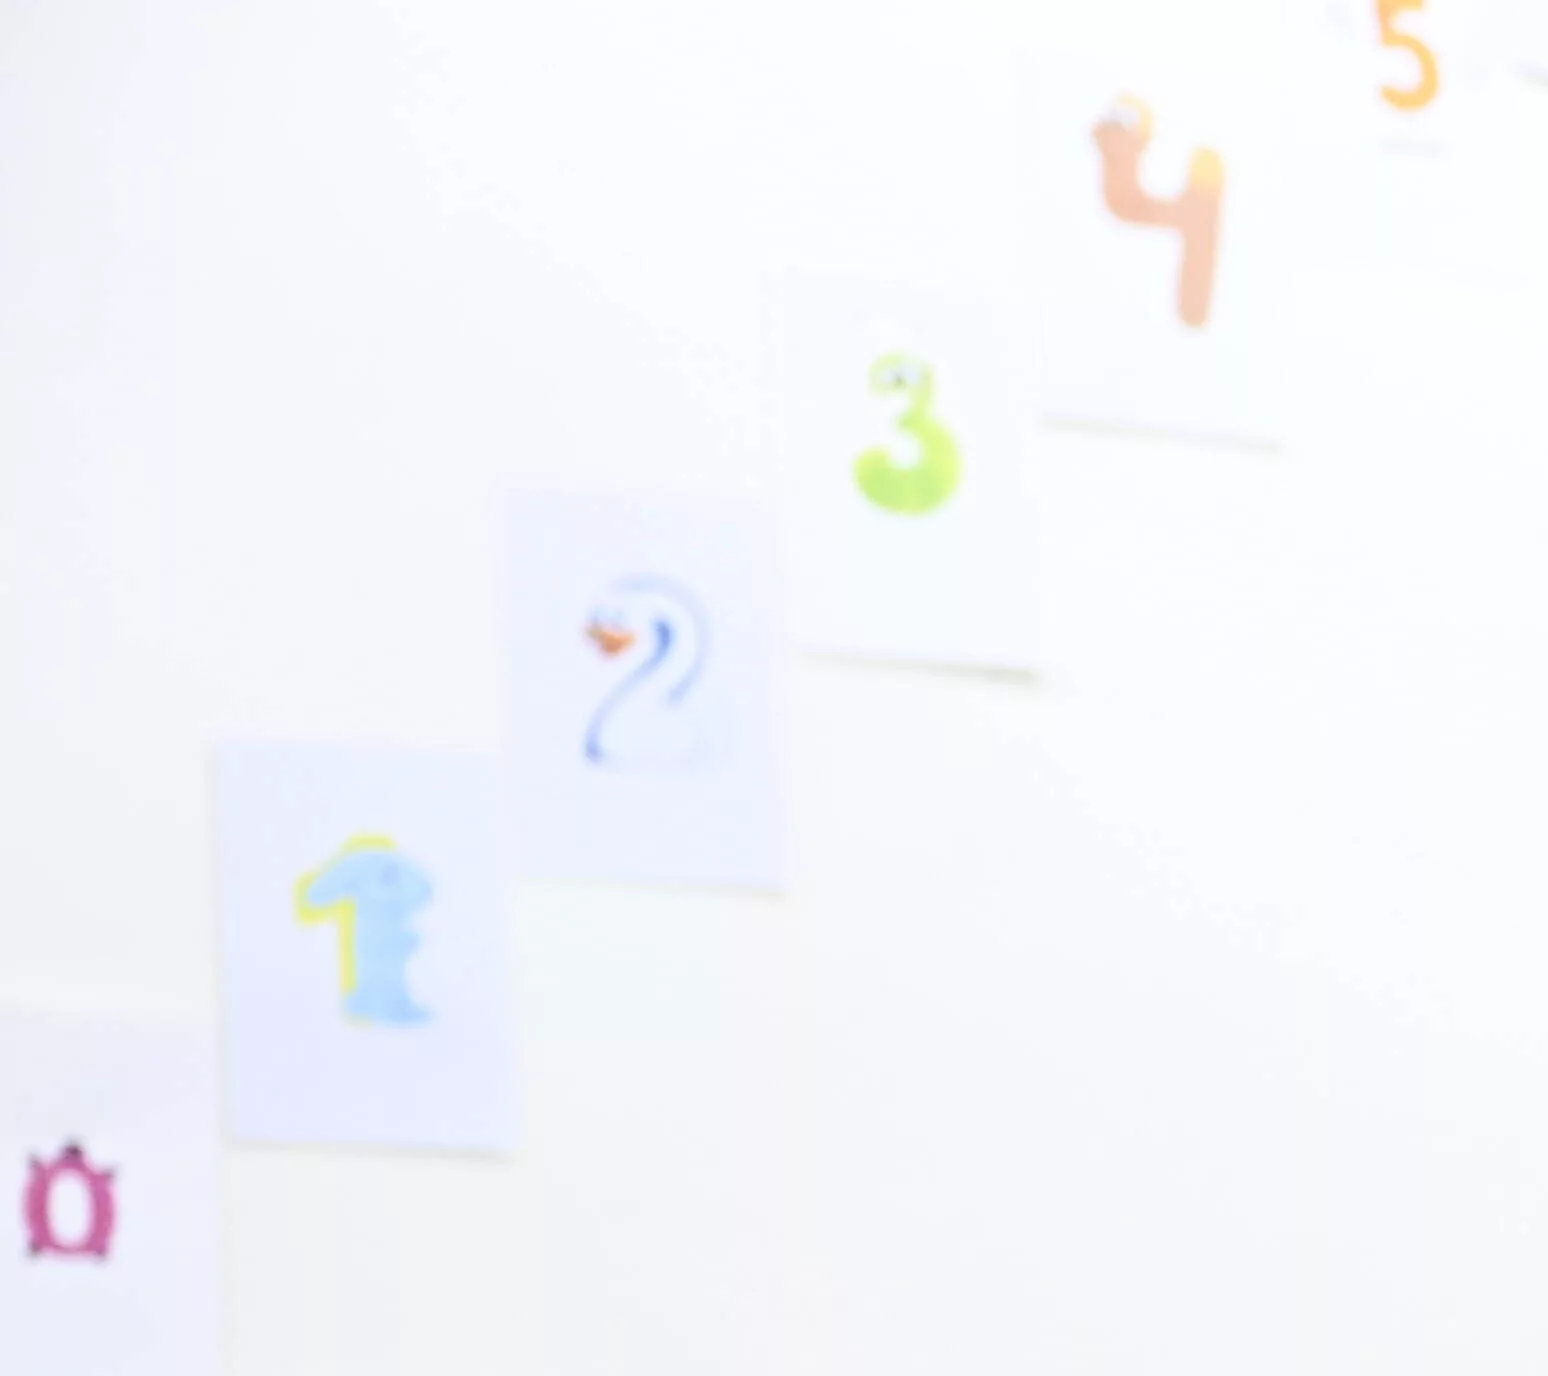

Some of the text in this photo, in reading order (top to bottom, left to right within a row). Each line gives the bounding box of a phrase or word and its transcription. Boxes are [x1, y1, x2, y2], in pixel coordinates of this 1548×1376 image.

[1372, 0, 1441, 113] 5
[1091, 95, 1225, 328] 4
[851, 351, 964, 518] 3
[582, 573, 732, 772] 2
[291, 831, 434, 1027] 1
